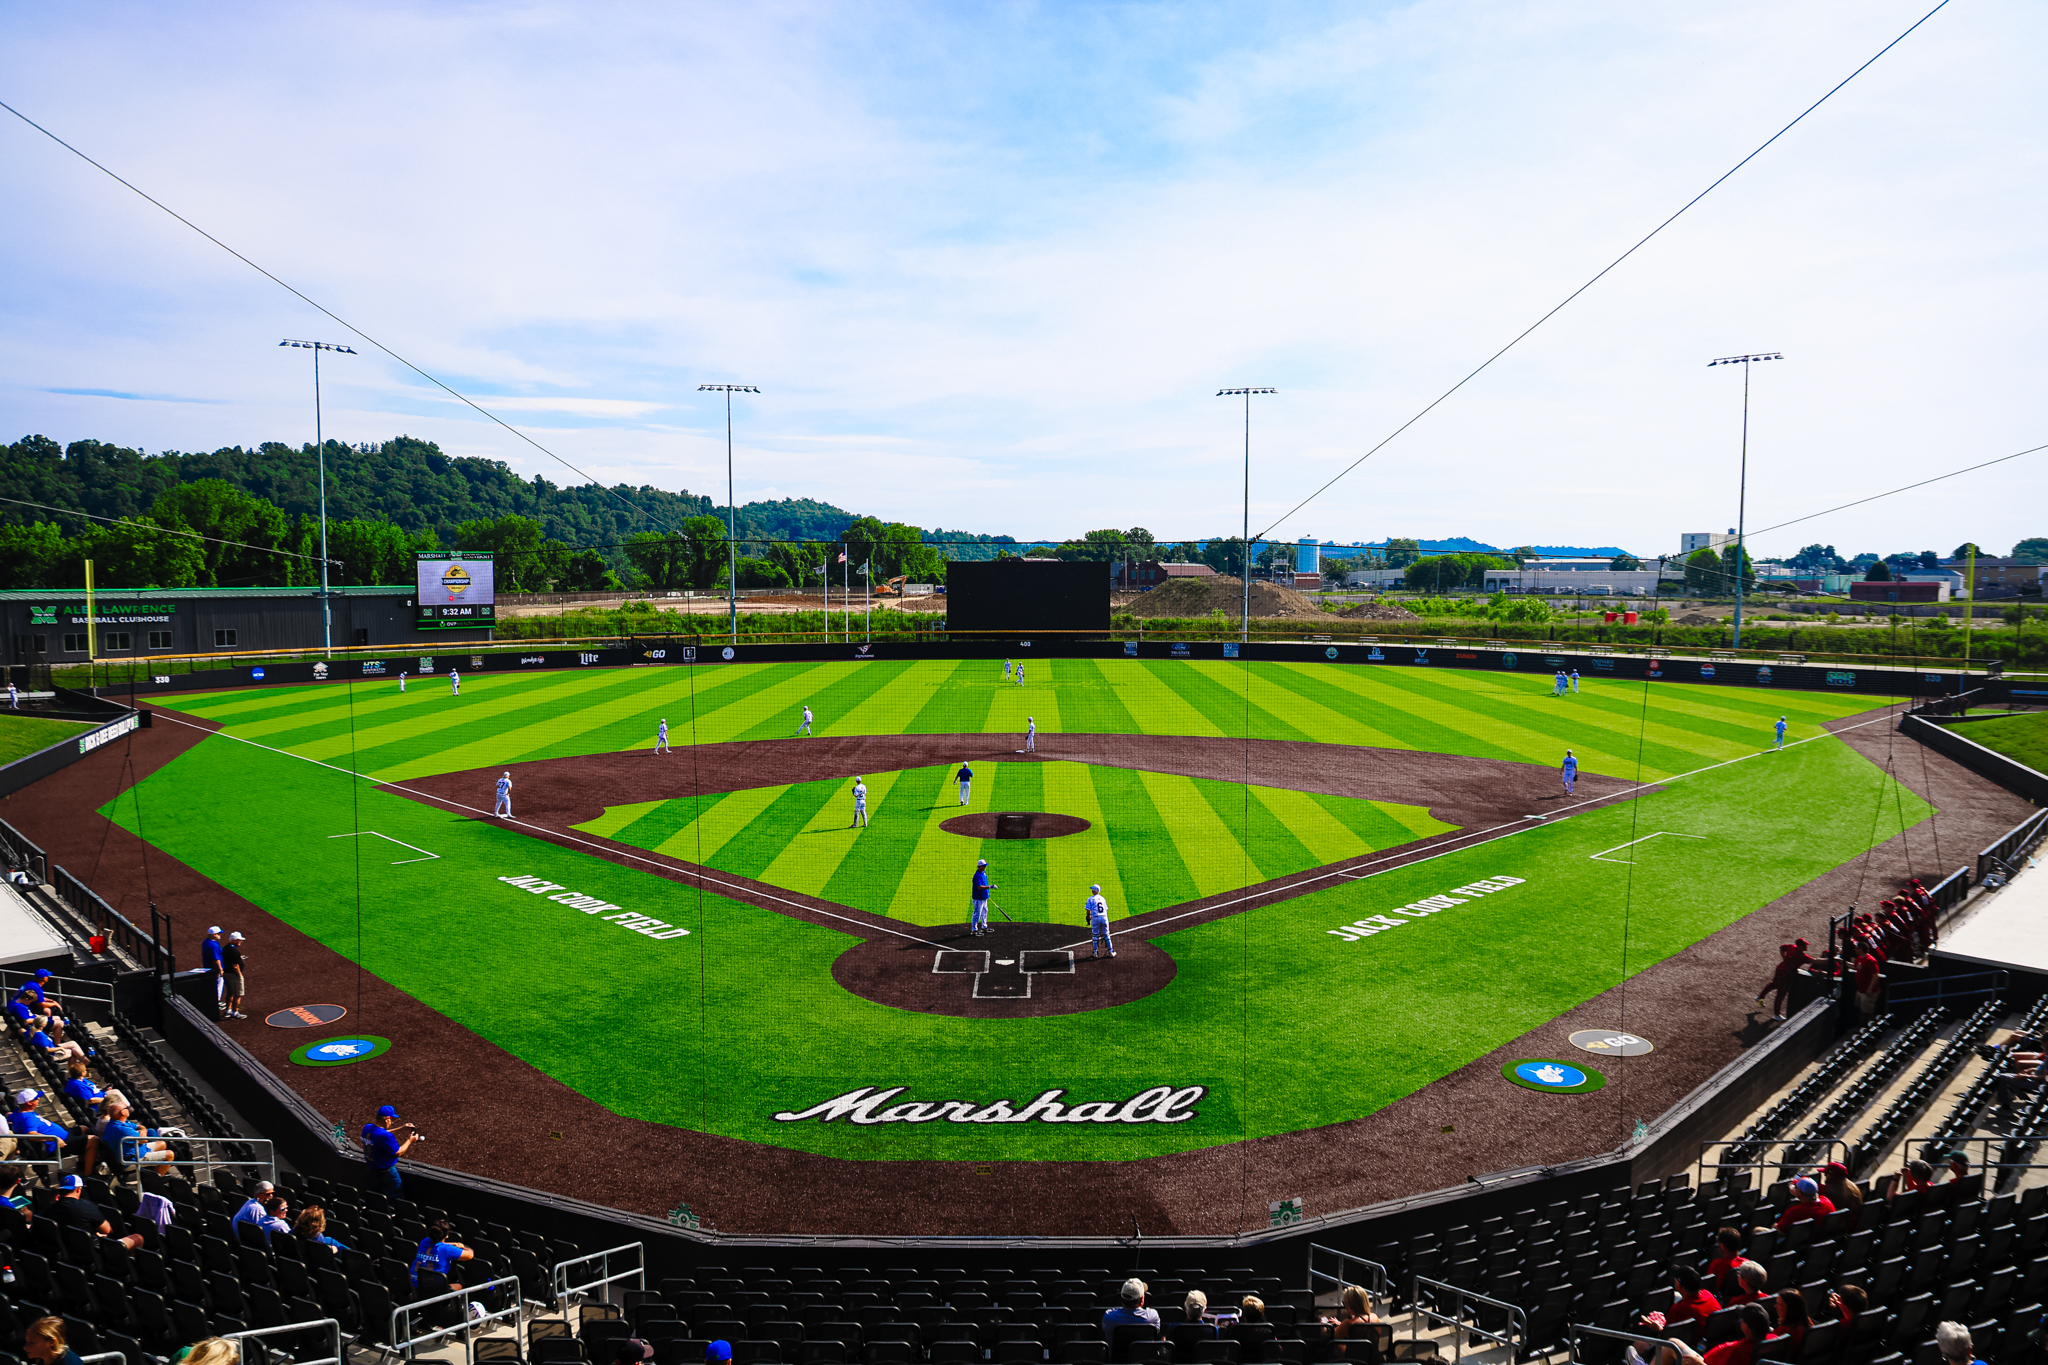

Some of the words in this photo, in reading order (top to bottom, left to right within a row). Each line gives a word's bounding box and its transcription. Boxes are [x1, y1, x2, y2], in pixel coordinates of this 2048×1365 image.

[64, 605, 98, 615] ALEX
[102, 604, 176, 614] LAWRENCE
[460, 608, 472, 616] AM
[72, 616, 117, 624] BASEBALL
[580, 653, 599, 665] Lite
[652, 650, 666, 658] GO
[363, 661, 380, 669] HTS
[154, 675, 170, 684] 330
[498, 874, 566, 895] JACK
[547, 892, 622, 915] COOK
[601, 912, 691, 940] FIELD
[1097, 902, 1104, 913] 6
[1327, 914, 1409, 942] JACK
[1392, 894, 1470, 917] COOK
[1450, 875, 1527, 897] FIELD
[1603, 1034, 1640, 1047] GO
[770, 1085, 1209, 1124] Marshall
